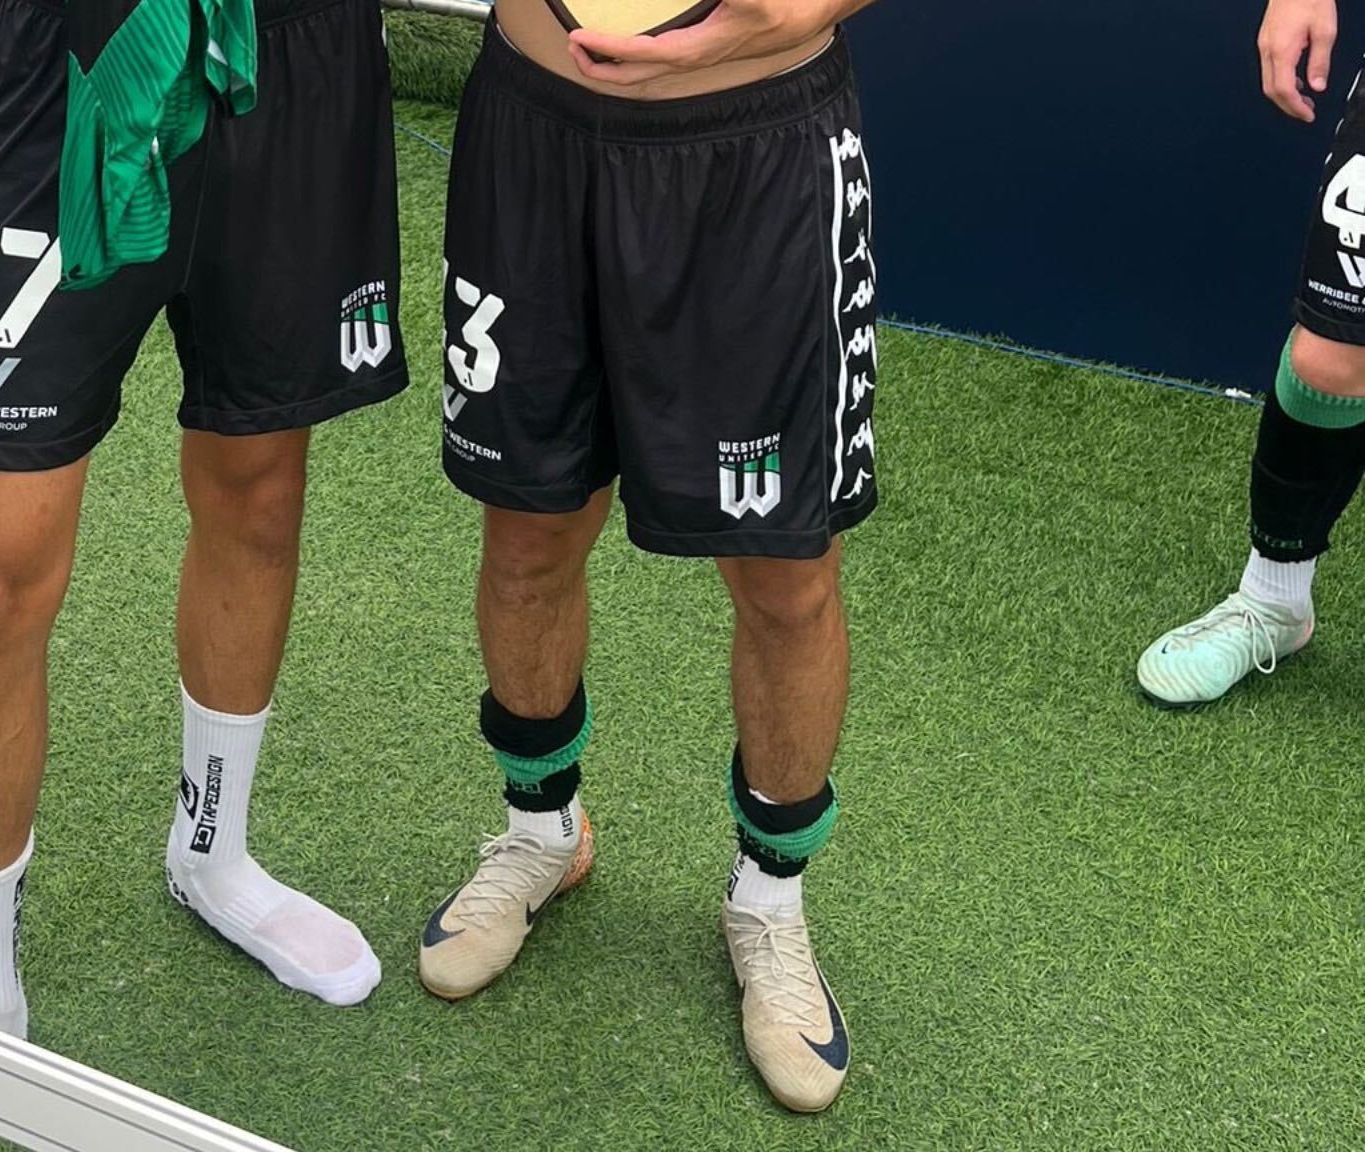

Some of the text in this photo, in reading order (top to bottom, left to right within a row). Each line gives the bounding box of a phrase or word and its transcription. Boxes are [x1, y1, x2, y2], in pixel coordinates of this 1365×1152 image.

[341, 280, 385, 308] WESTERN
[1308, 279, 1359, 304] WERRIBEE
[443, 258, 505, 392] 3
[450, 432, 501, 460] WESTERN
[718, 432, 780, 453] WESTERN
[719, 450, 763, 462] UNITED
[200, 754, 224, 824] TAPEDESIGN
